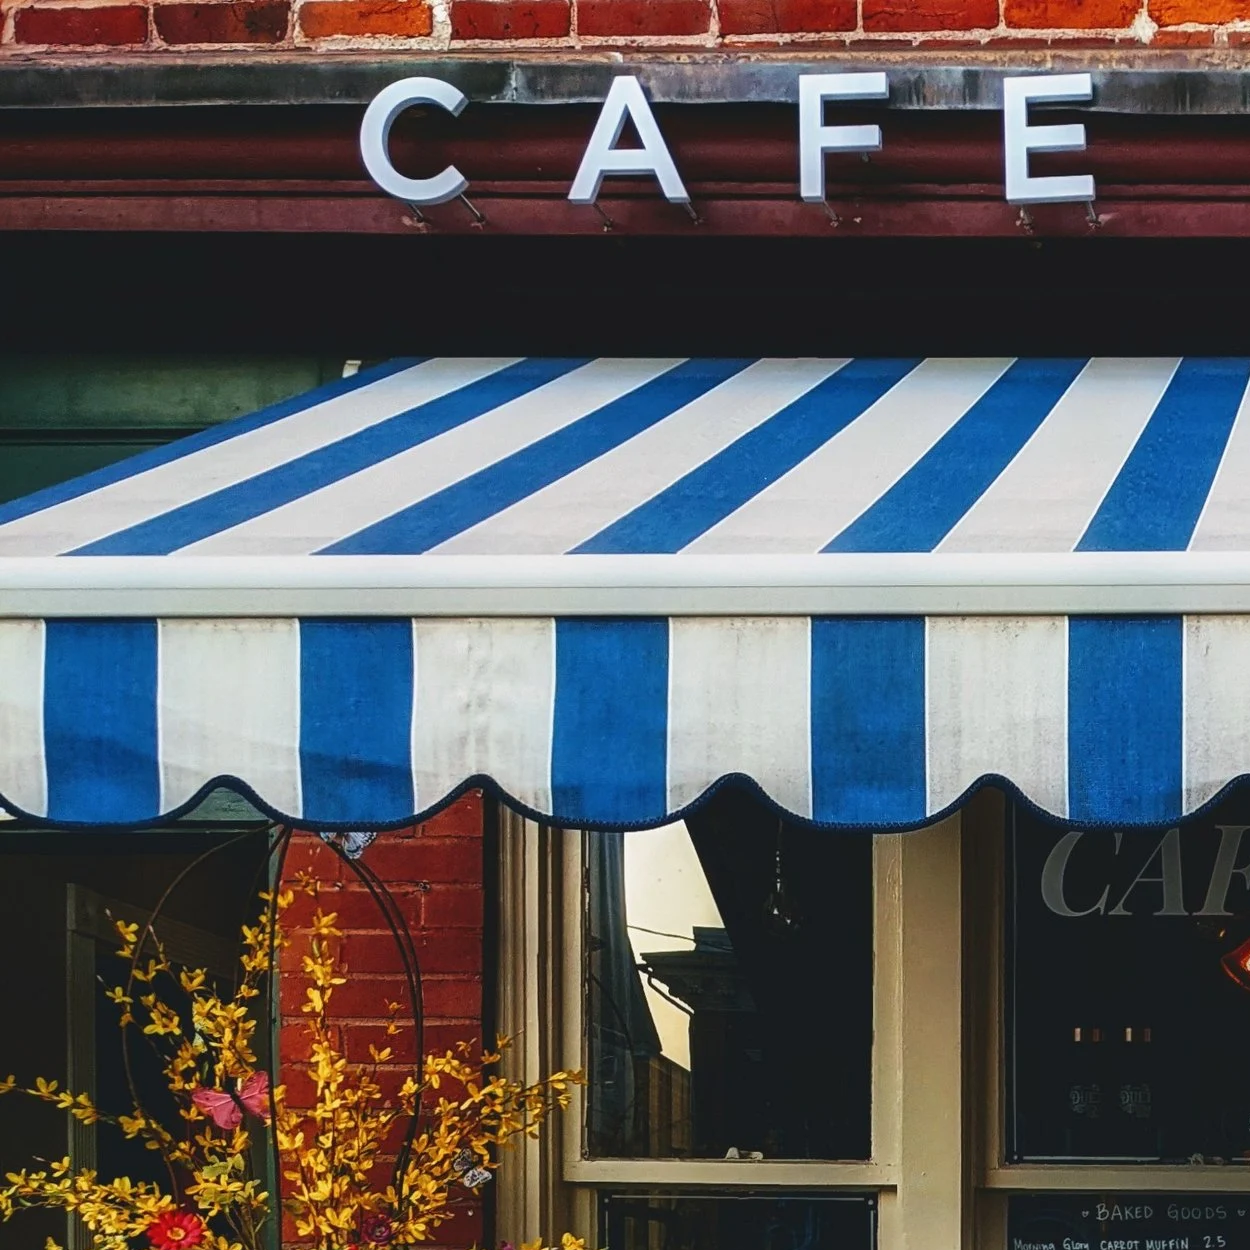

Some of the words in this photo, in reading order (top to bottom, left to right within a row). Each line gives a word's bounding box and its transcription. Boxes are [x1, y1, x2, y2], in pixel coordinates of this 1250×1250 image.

[359, 72, 1096, 204] CAFE
[1096, 1203, 1153, 1221] BAKED
[1167, 1203, 1228, 1221] GOODS
[1100, 1240, 1140, 1250] CARROT
[1203, 1235, 1226, 1249] 2.5
